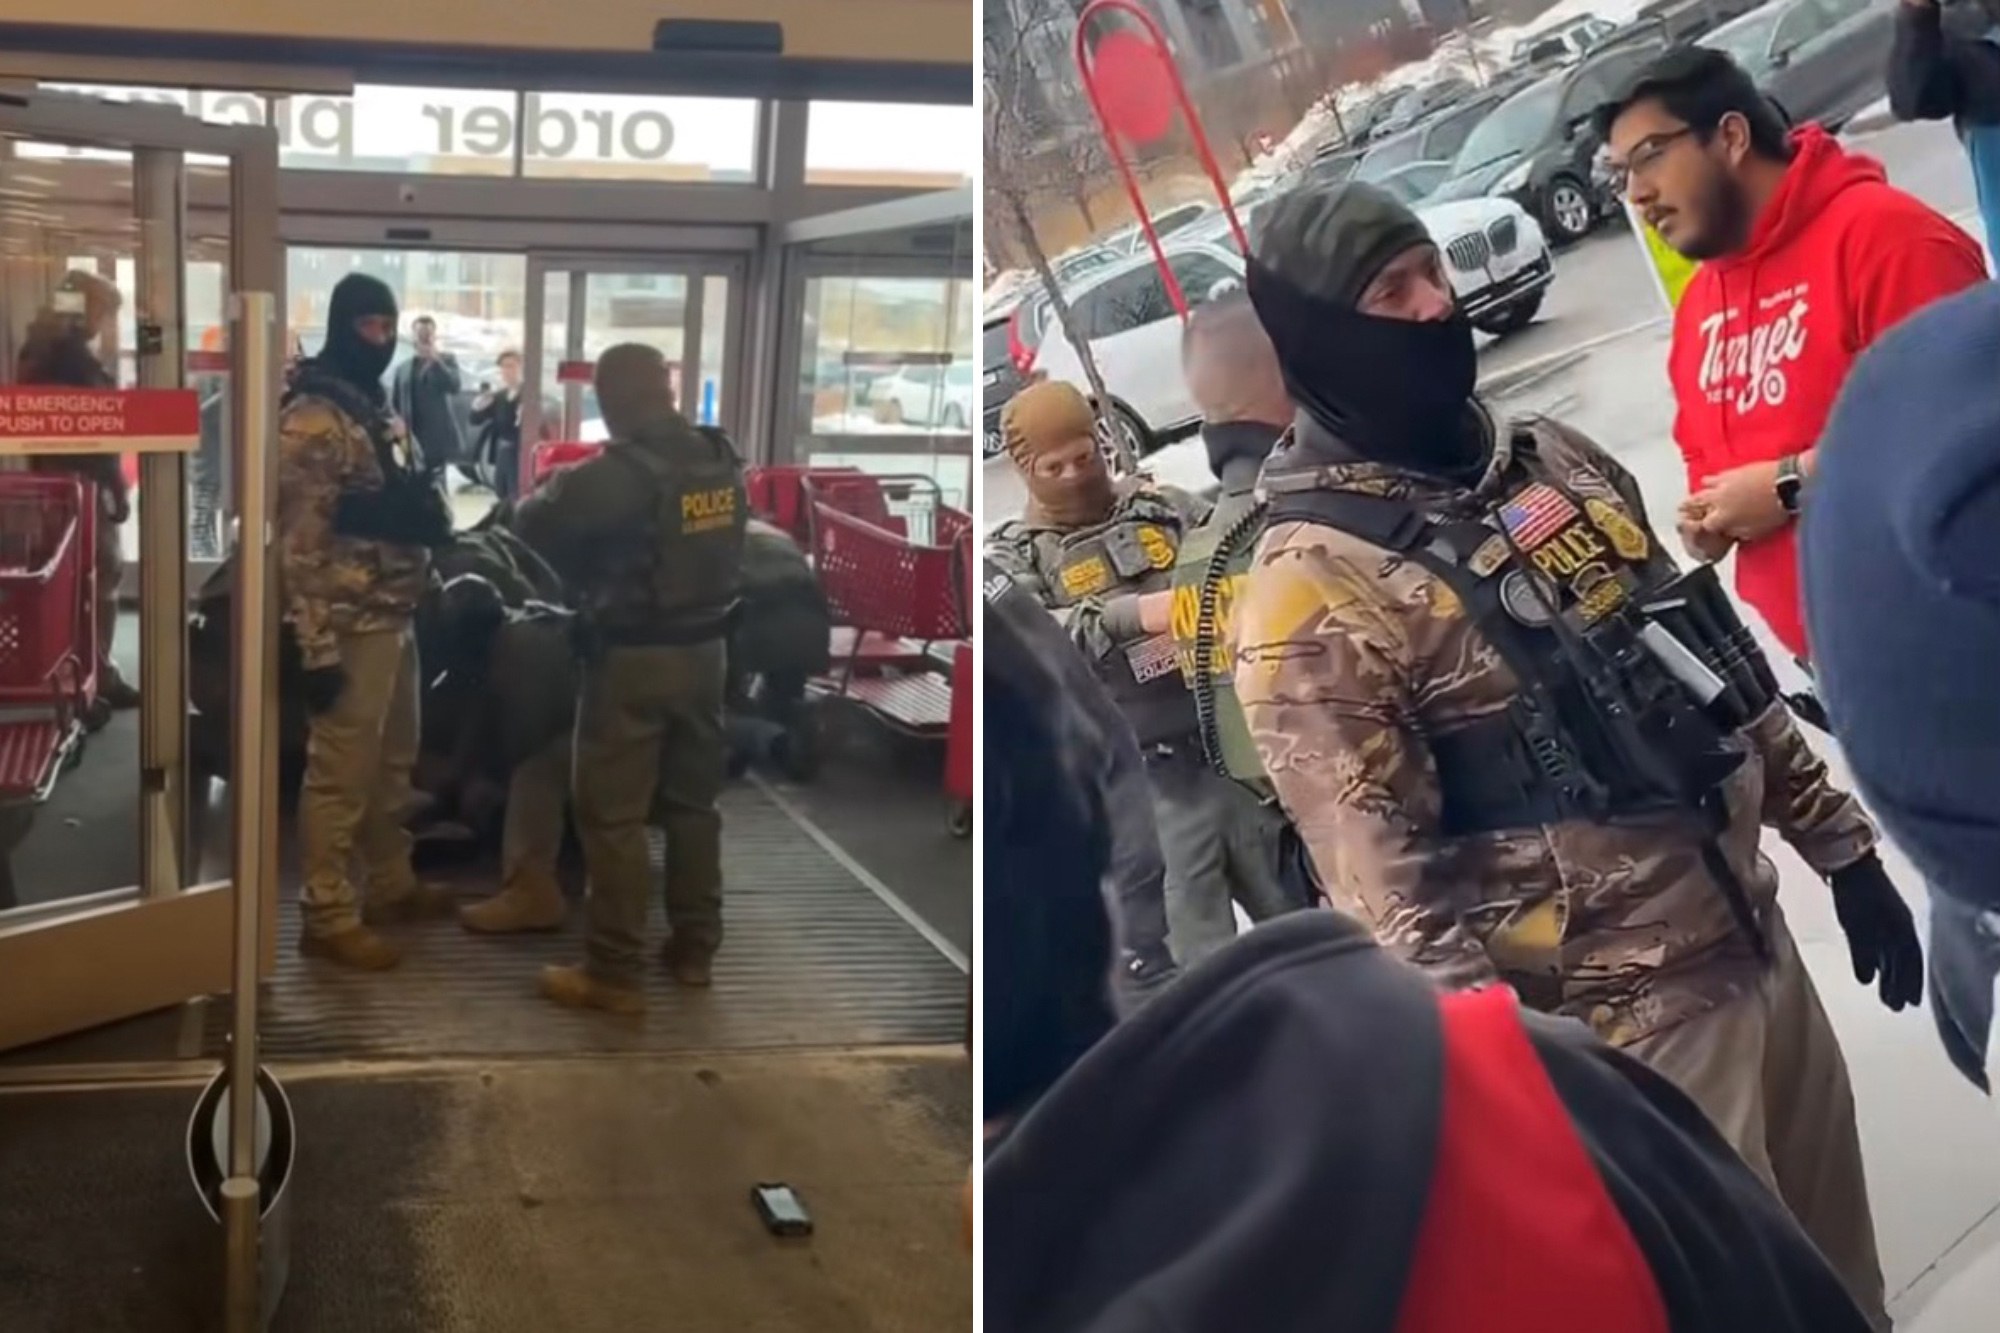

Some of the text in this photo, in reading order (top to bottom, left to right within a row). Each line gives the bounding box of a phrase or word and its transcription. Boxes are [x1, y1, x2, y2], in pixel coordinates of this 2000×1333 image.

[1699, 299, 1809, 413] Target
[16, 395, 126, 412] EMERGENCY
[0, 414, 125, 433] PUSH TO OPEN
[681, 487, 735, 519] POLICE
[1531, 522, 1605, 583] POLICE
